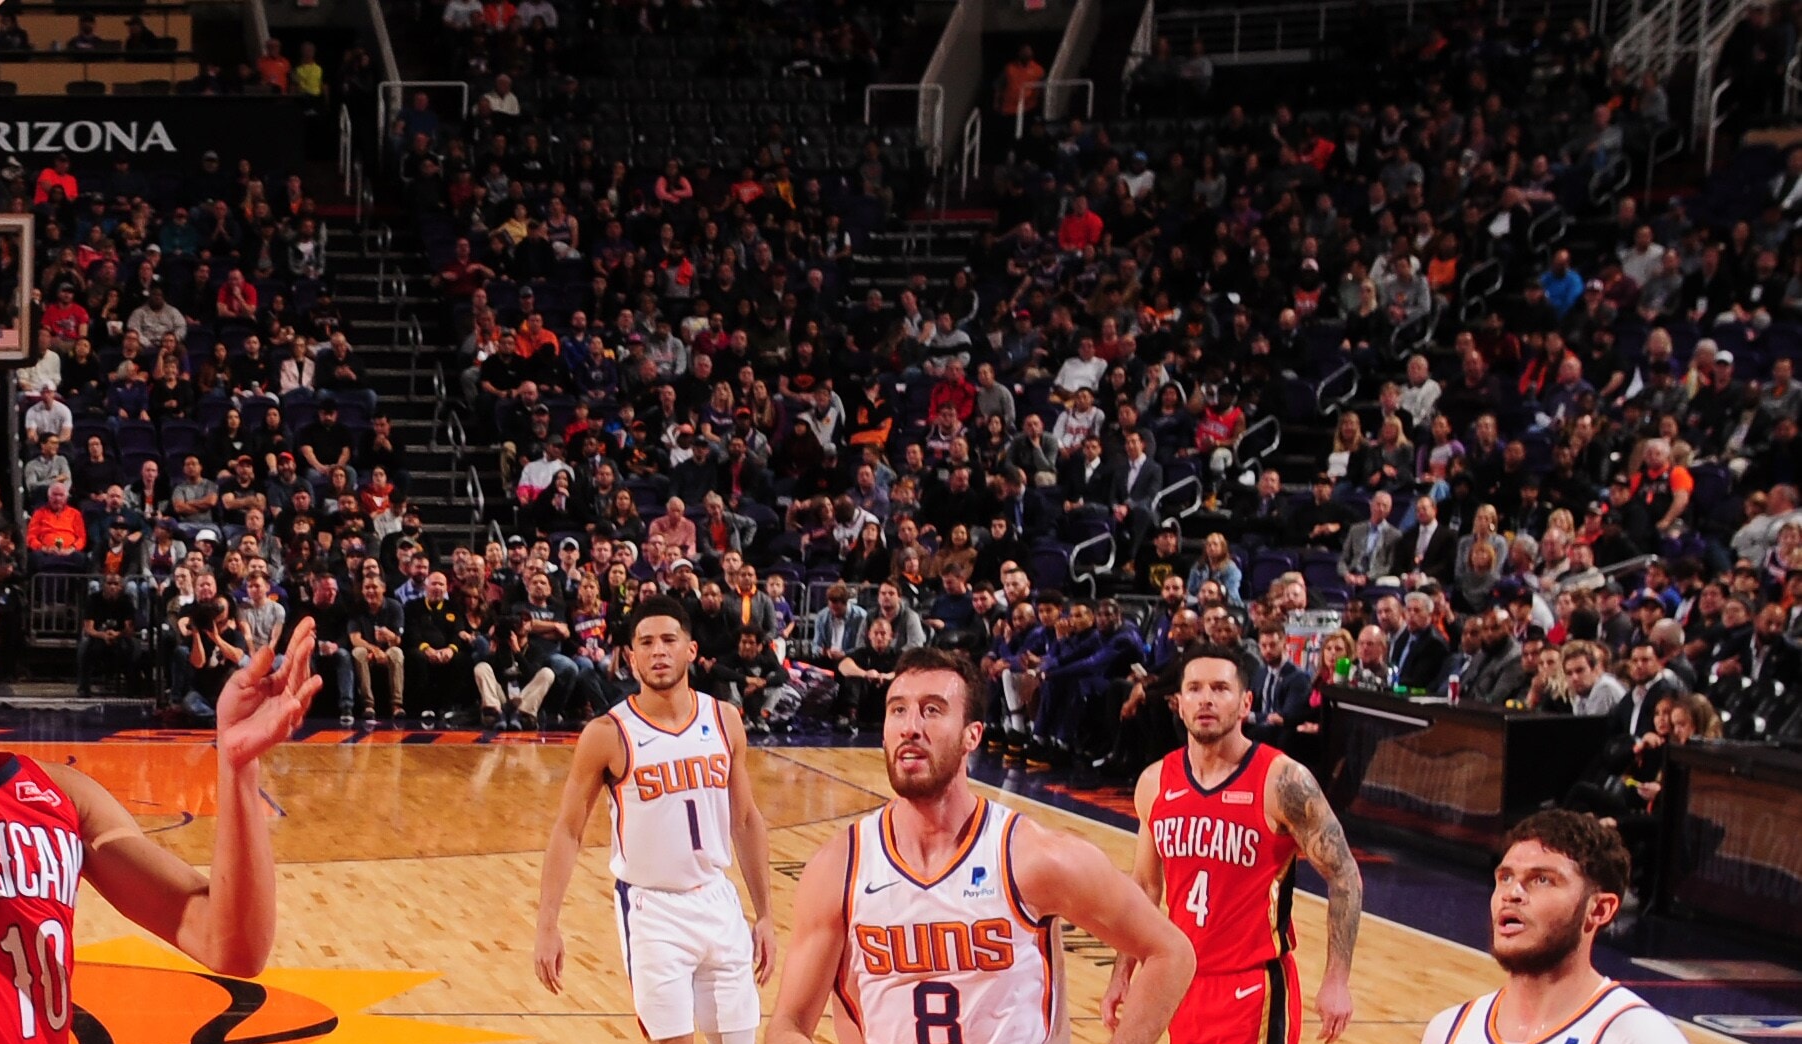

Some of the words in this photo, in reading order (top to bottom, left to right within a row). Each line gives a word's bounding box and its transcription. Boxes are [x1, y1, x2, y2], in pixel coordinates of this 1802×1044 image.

[633, 753, 728, 802] SUNS
[684, 799, 703, 851] 1
[1153, 816, 1260, 867] PELICANS
[1186, 870, 1209, 928] 4
[855, 917, 1015, 976] SUNS
[0, 918, 69, 1040] 10
